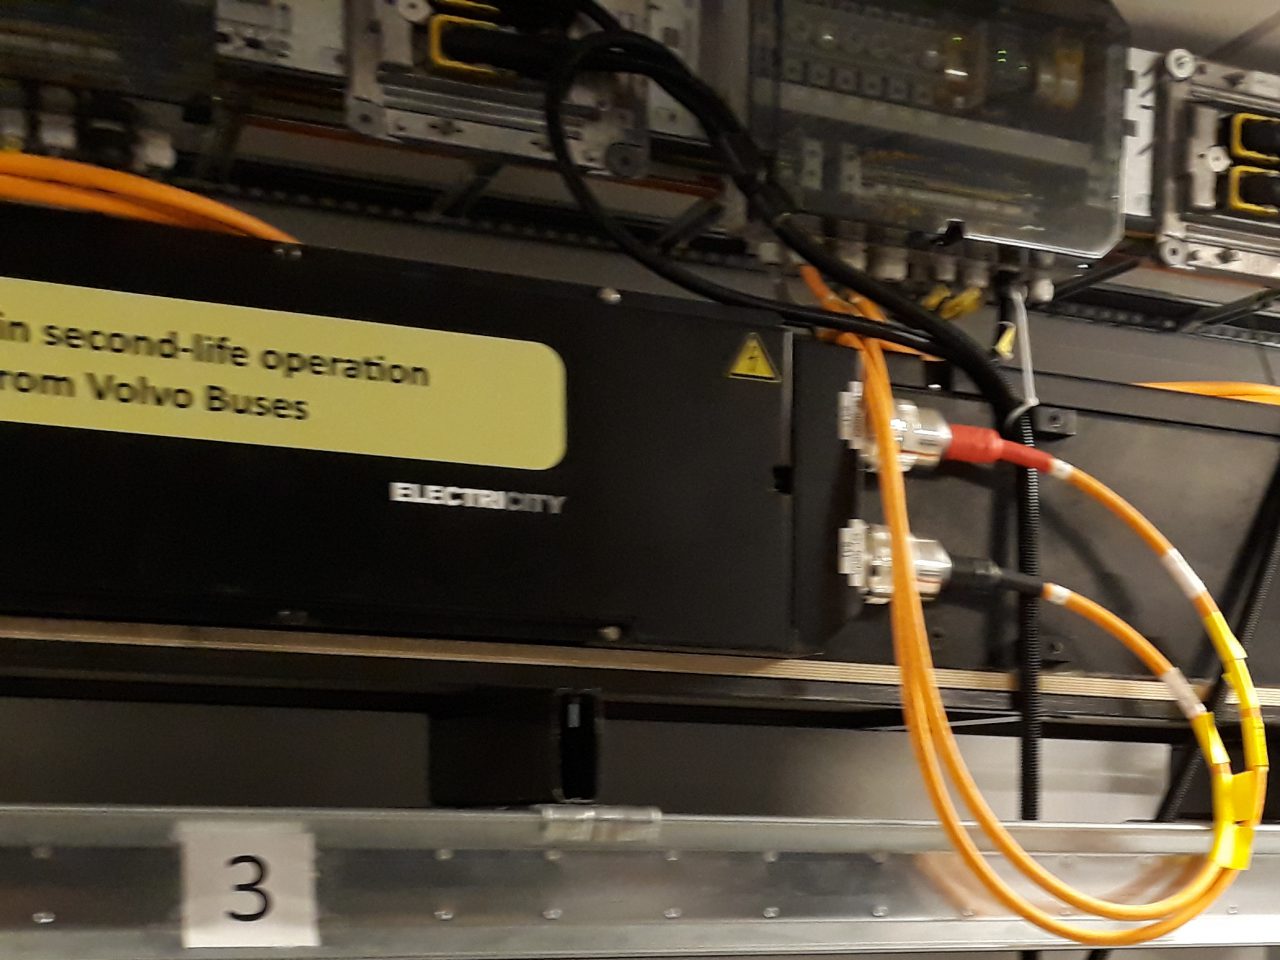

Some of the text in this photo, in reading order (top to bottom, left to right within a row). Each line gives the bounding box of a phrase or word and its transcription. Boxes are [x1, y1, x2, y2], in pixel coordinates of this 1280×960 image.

[0, 310, 430, 387] in second-life operation
[0, 369, 309, 421] rom Volvo Buses
[388, 482, 567, 514] ELECTRICITY
[225, 854, 272, 922] 3
